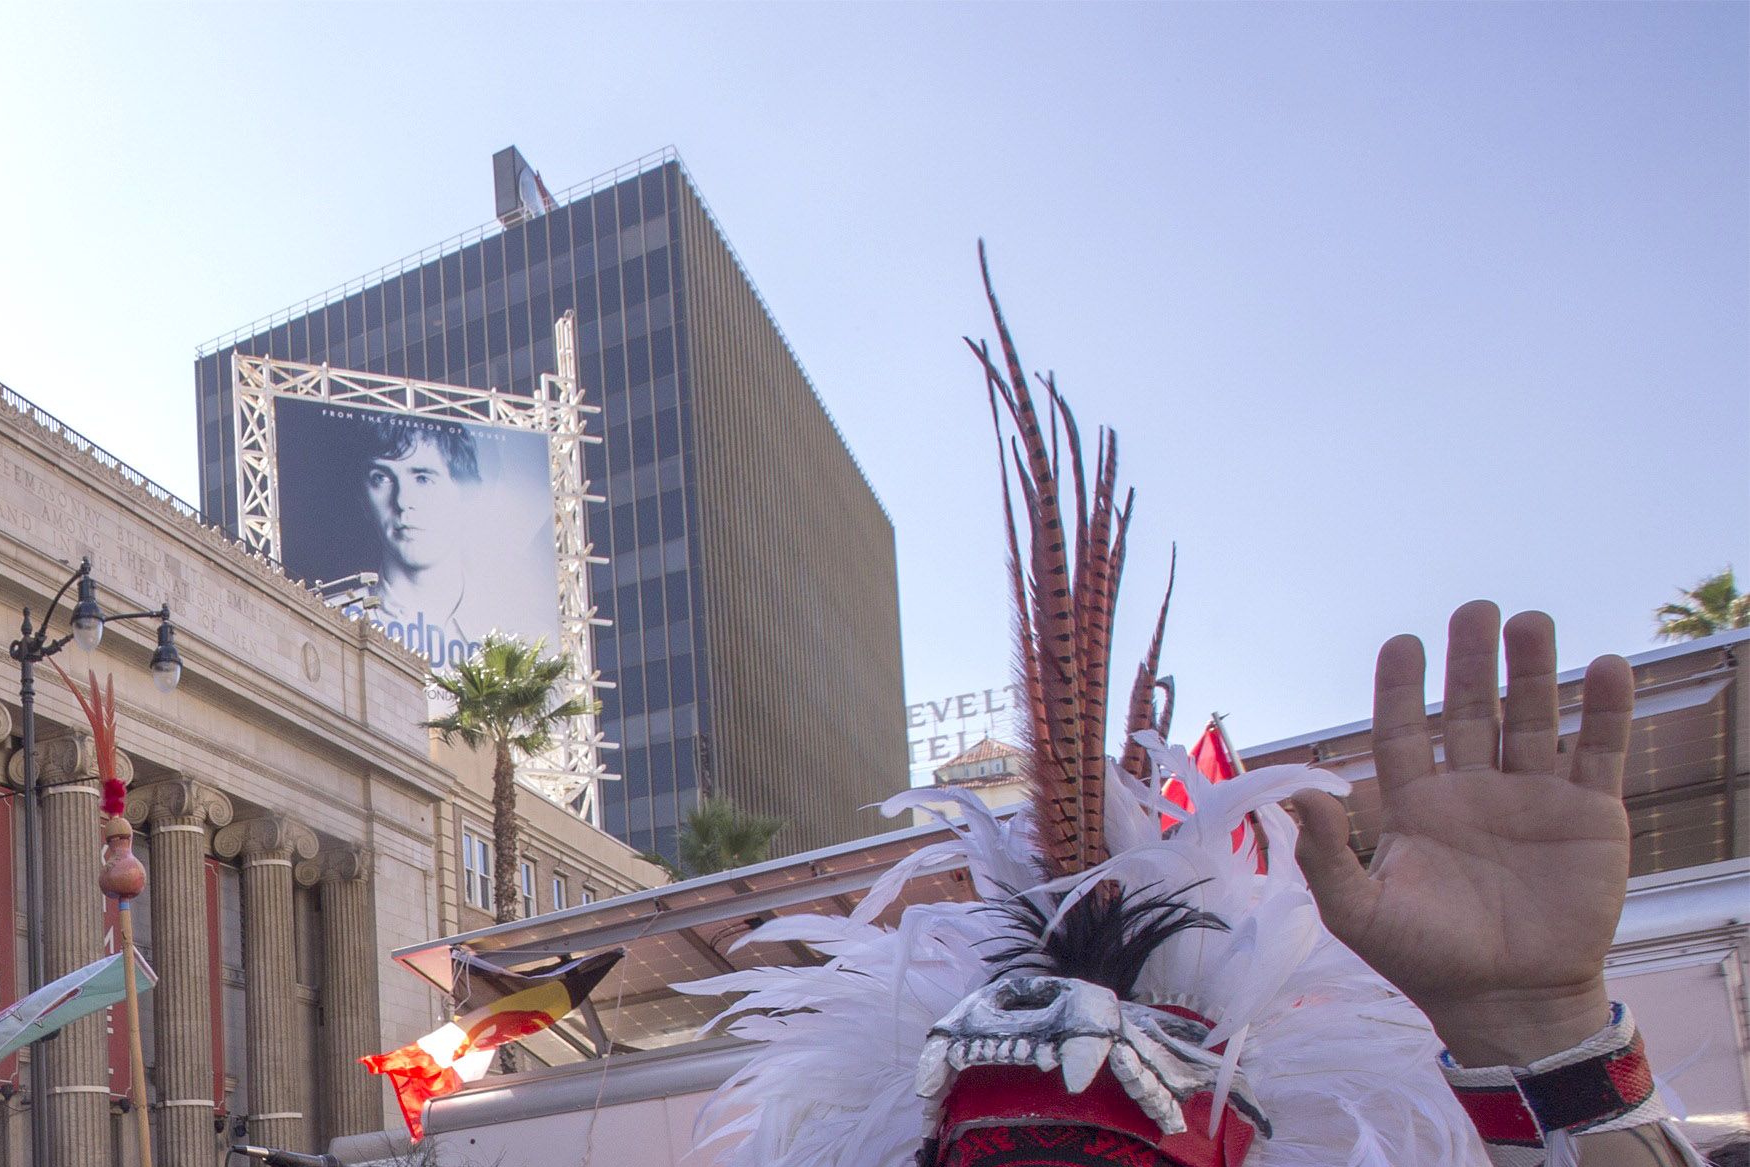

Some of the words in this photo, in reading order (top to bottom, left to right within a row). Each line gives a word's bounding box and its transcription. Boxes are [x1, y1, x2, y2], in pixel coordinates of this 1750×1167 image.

[322, 409, 353, 420] FROM
[361, 414, 382, 424] THE
[389, 418, 442, 432] CREATOR
[449, 427, 462, 435] OF
[471, 430, 507, 442] HOUSE
[41, 505, 101, 548] AMONG
[117, 547, 146, 575] THE
[53, 531, 70, 551] IN
[201, 614, 218, 634] OF
